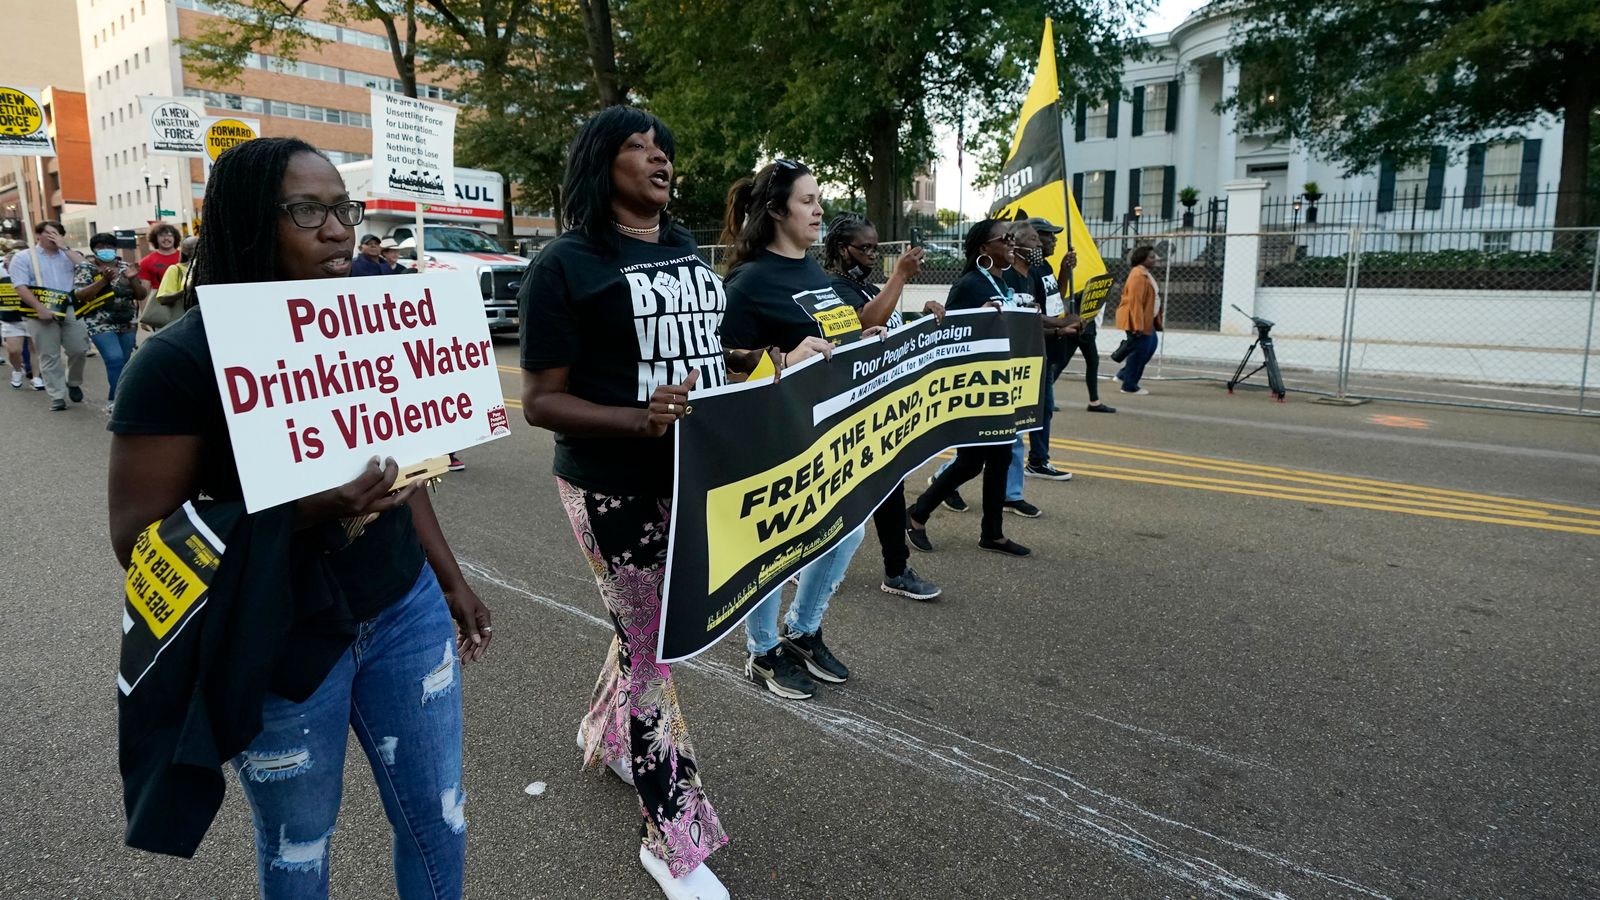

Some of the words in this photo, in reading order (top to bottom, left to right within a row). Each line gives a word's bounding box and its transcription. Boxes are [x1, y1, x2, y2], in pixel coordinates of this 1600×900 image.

[0, 104, 39, 117] ETTLING
[161, 107, 168, 117] A
[170, 108, 189, 119] NEW
[385, 94, 399, 104] We
[399, 99, 412, 107] are
[419, 102, 435, 113] New
[0, 114, 30, 127] ORCE
[155, 119, 200, 128] UNSETTLING
[386, 107, 424, 123] Unsettling
[424, 115, 443, 127] Force
[386, 118, 396, 127] for
[165, 128, 195, 139] FORCE
[211, 126, 252, 138] FORWARD
[386, 131, 400, 141] and
[401, 133, 414, 143] We
[415, 135, 427, 145] Got
[210, 137, 250, 147] TOGETHE
[386, 142, 417, 155] Nothing
[424, 149, 439, 159] Lose
[387, 154, 400, 163] But
[402, 156, 415, 165] Our
[994, 165, 1034, 202] aign
[454, 184, 494, 203] AUL
[654, 260, 670, 268] YOU
[286, 288, 438, 343] Polluted
[852, 357, 882, 380] Poor
[882, 337, 916, 367] People's
[917, 325, 973, 349] Campaign
[224, 350, 399, 415] Drinking
[402, 336, 491, 380] Water
[637, 353, 729, 402] MATTE
[850, 391, 857, 402] A
[857, 374, 890, 398] NATIONAL
[890, 365, 904, 381] CALL
[906, 361, 917, 371] for
[918, 353, 935, 366] MORAL
[935, 344, 972, 357] REVIVAL
[286, 417, 325, 463] is
[331, 391, 474, 450] Violence
[739, 452, 825, 519] FREE
[829, 418, 866, 463] THE
[871, 387, 923, 432] LAND,
[928, 369, 1011, 398] CLEAN
[1010, 365, 1031, 381] HE
[756, 463, 855, 543] WATER
[860, 446, 875, 469] &
[880, 412, 921, 456] KEEP
[926, 400, 942, 423] IT
[131, 571, 152, 600] THE
[150, 555, 191, 600] WATER
[145, 590, 176, 623] FREE
[707, 579, 758, 625] REPAIRERS
